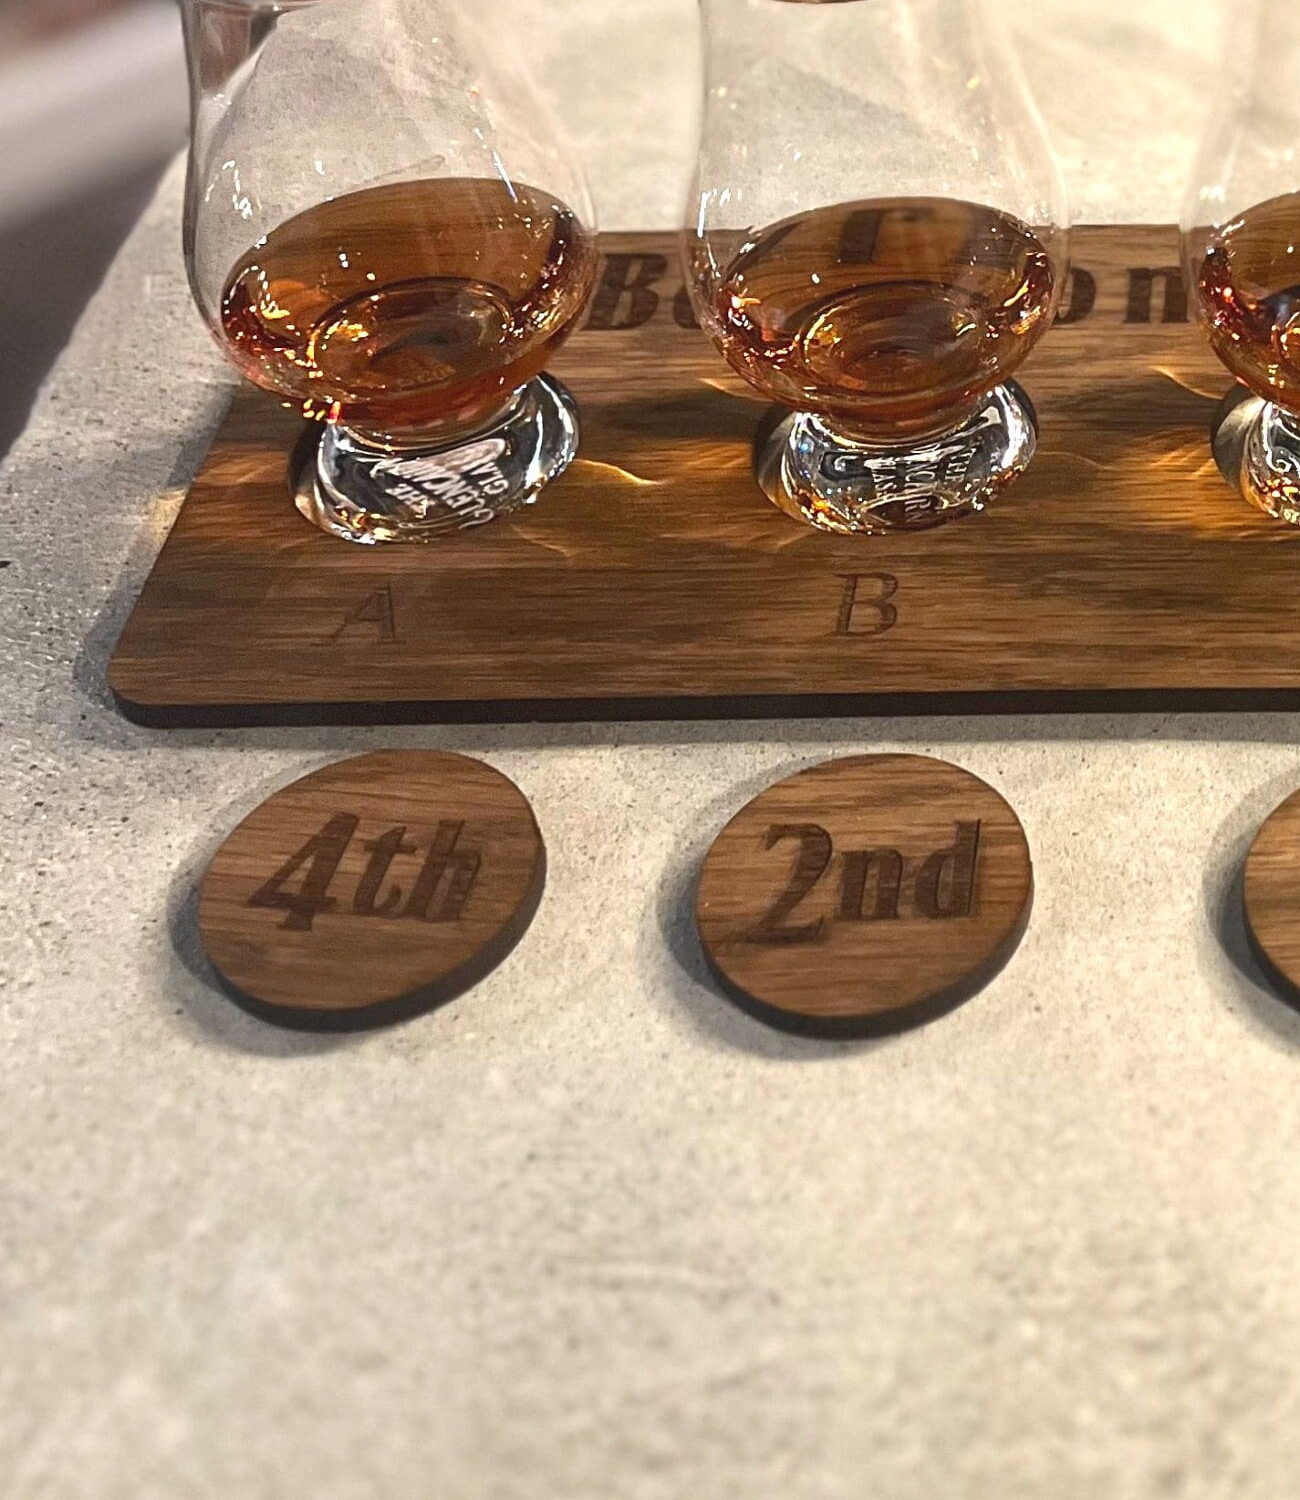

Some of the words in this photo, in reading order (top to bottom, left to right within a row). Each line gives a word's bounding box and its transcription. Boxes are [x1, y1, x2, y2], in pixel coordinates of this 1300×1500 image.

[310, 581, 406, 645] A
[824, 570, 900, 637] B
[247, 811, 482, 932] 4th
[746, 818, 983, 945] 2nd
